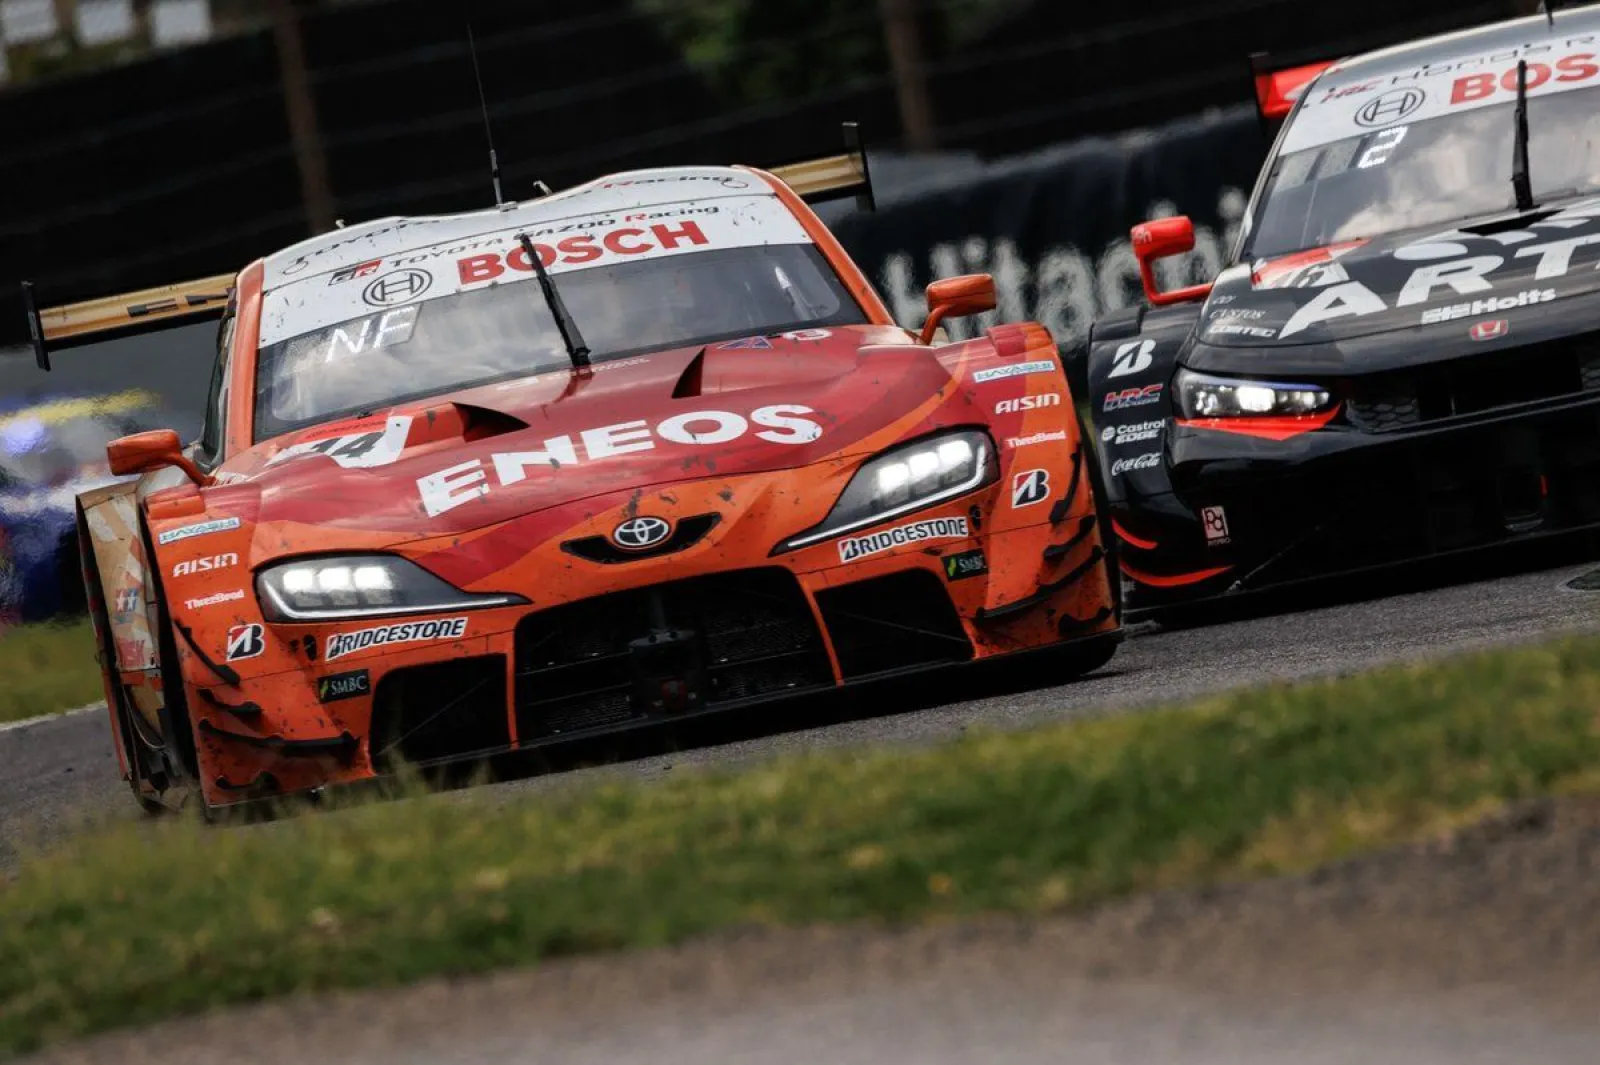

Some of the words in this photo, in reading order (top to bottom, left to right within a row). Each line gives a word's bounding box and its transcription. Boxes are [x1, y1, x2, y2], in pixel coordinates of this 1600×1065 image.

[1449, 53, 1600, 106] BOS
[1357, 126, 1409, 169] 2
[389, 237, 505, 269] TOYOTA
[512, 218, 617, 241] GAZOO
[623, 205, 720, 223] Racing
[456, 219, 710, 286] BOSCH
[1277, 230, 1600, 340] ART
[1471, 287, 1557, 316] Holts
[325, 305, 416, 363] NF
[311, 431, 386, 459] 14
[1115, 429, 1159, 445] EDGE
[1116, 418, 1166, 434] Castrol
[415, 403, 823, 519] ENEOS
[841, 517, 968, 562] BRIDGESTONE
[326, 618, 466, 660] BRIDGESTONE
[330, 674, 367, 696] SMBC
